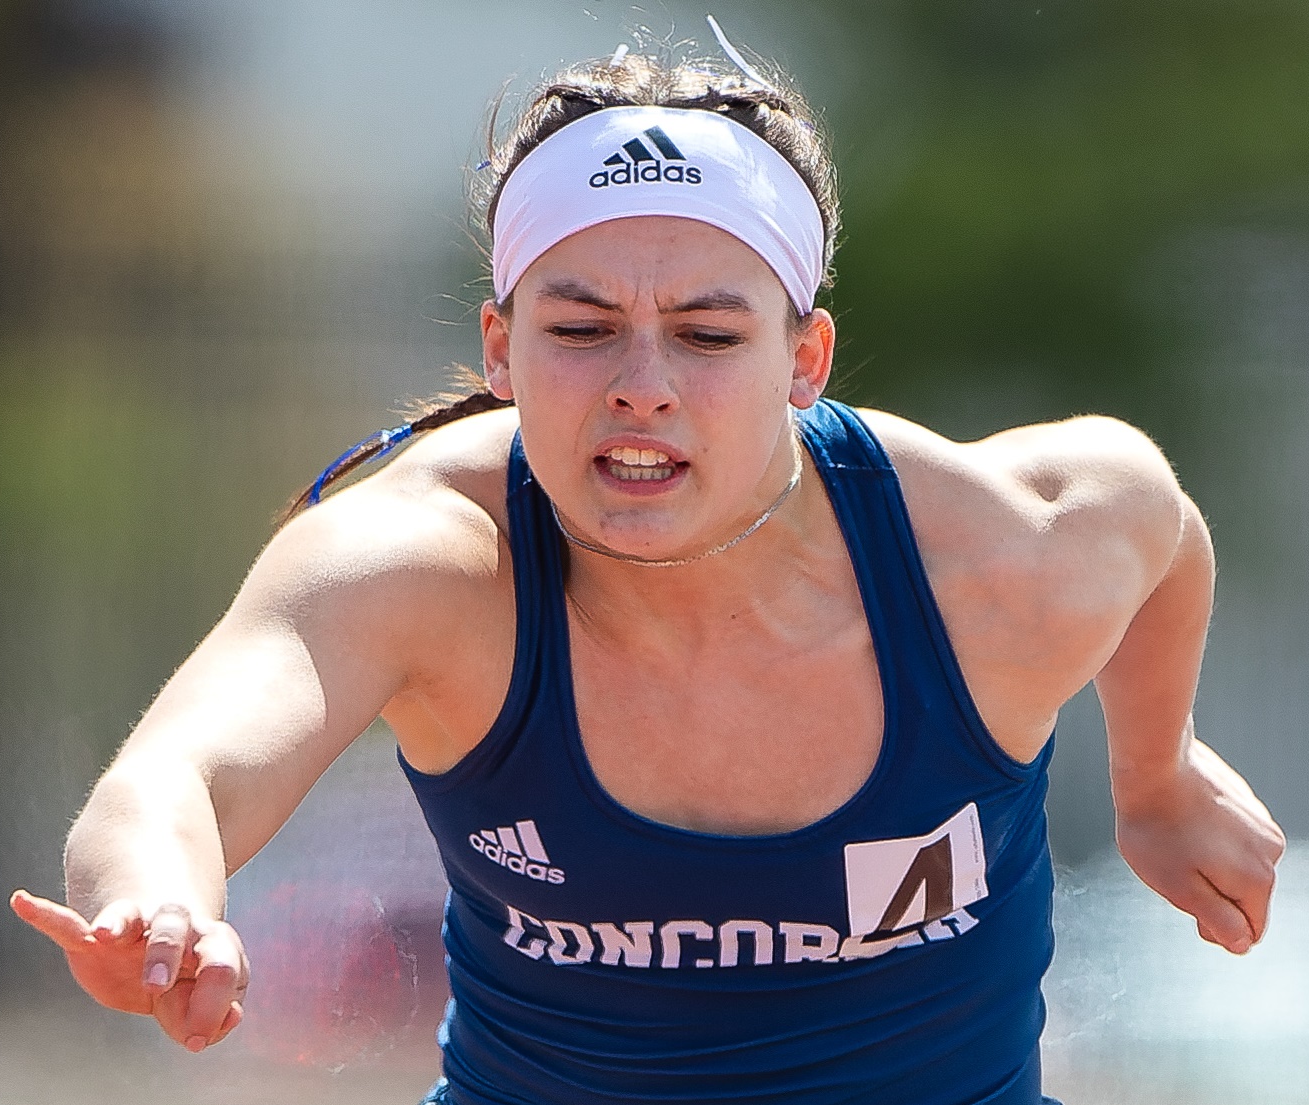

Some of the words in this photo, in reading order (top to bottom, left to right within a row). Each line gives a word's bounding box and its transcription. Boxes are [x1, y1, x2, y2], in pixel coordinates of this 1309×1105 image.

[589, 158, 702, 189] adidas
[468, 833, 566, 885] adidas
[503, 904, 980, 967] CONCOR
